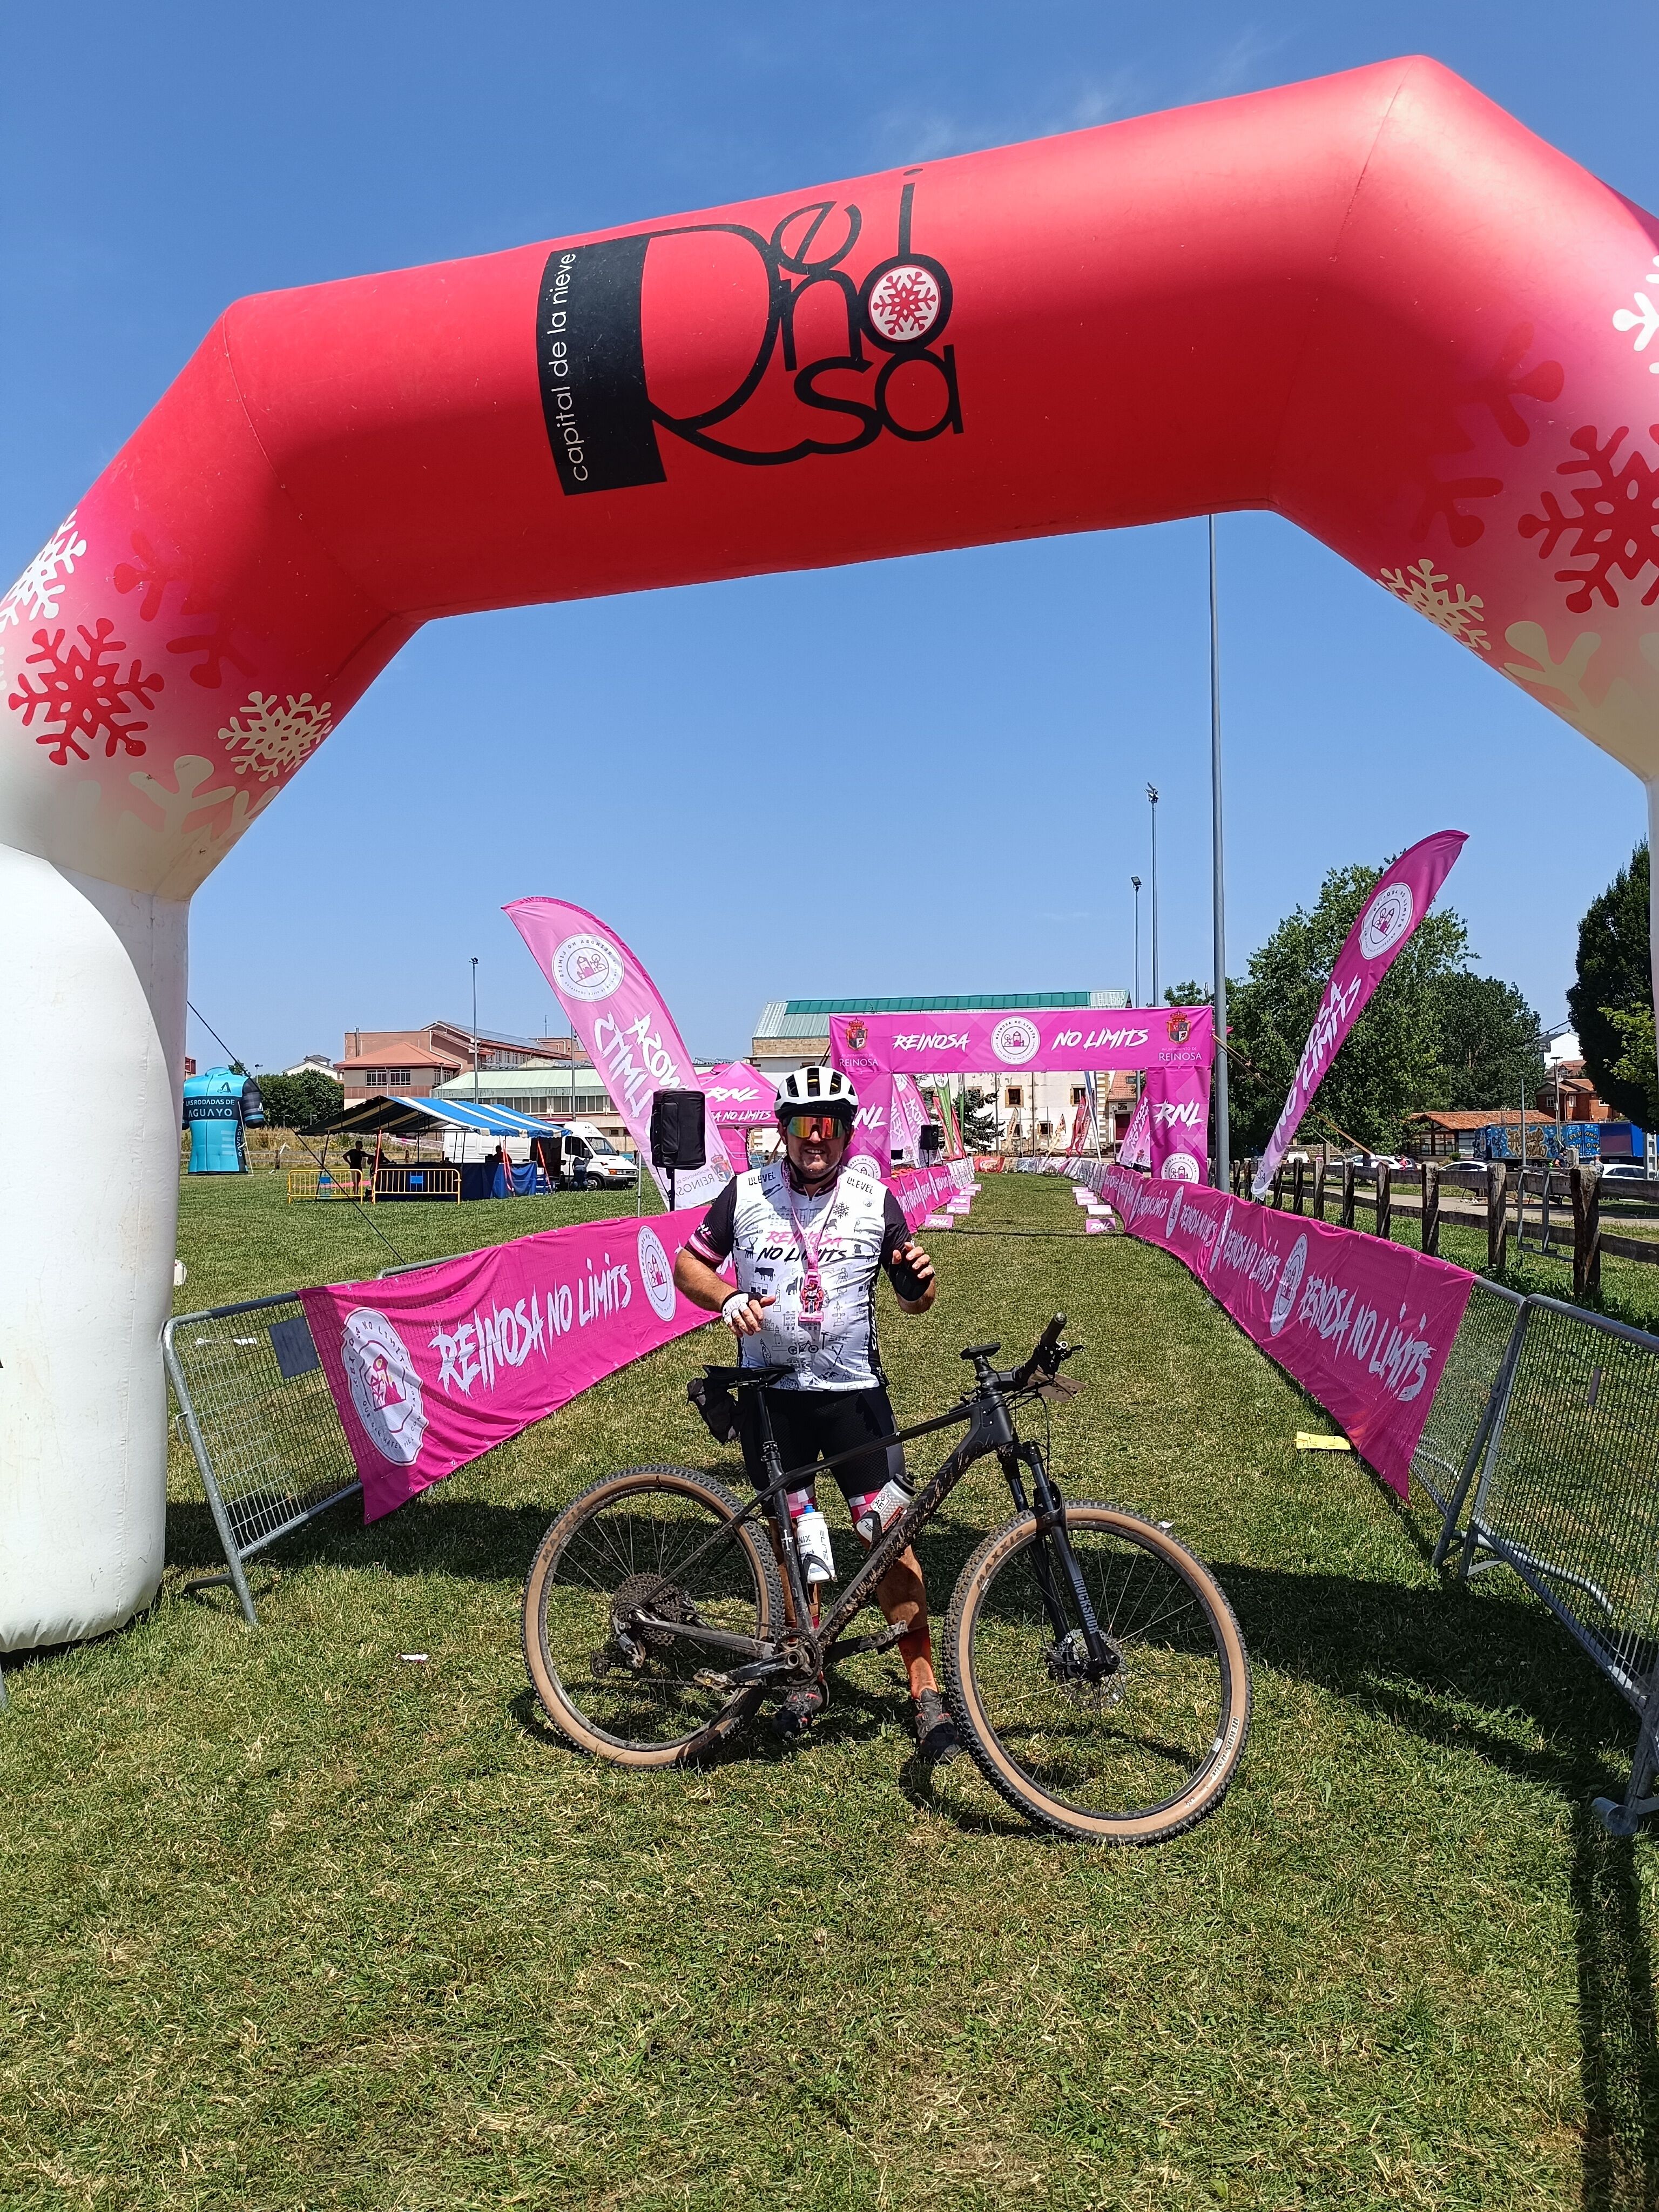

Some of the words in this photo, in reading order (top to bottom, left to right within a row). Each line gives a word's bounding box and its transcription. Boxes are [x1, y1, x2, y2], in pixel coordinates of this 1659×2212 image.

[549, 253, 576, 305] nieve
[547, 311, 567, 334] la
[548, 341, 568, 377] de
[550, 386, 588, 481] capital
[891, 1030, 971, 1053] REINOSA
[1051, 1028, 1083, 1051] NO
[1083, 1027, 1150, 1051] LIMITS
[839, 1058, 879, 1067] REINOSA
[1158, 1053, 1202, 1062] REINOSA
[188, 1108, 232, 1118] AGUAYO
[721, 1110, 738, 1122] NO
[738, 1110, 772, 1122] LIMITS
[852, 1102, 888, 1134] NL
[1152, 1098, 1204, 1131] RNL
[756, 1246, 783, 1263] NO
[1296, 1269, 1359, 1364] REINOSA
[1343, 1299, 1377, 1360] NO
[379, 1326, 407, 1362] LIMIT
[428, 1283, 549, 1400] REINOSA
[547, 1279, 573, 1350] NO
[542, 1505, 583, 1562] MAXXIS
[799, 1535, 811, 1544] NIX
[976, 1529, 1023, 1590] MAXXIS
